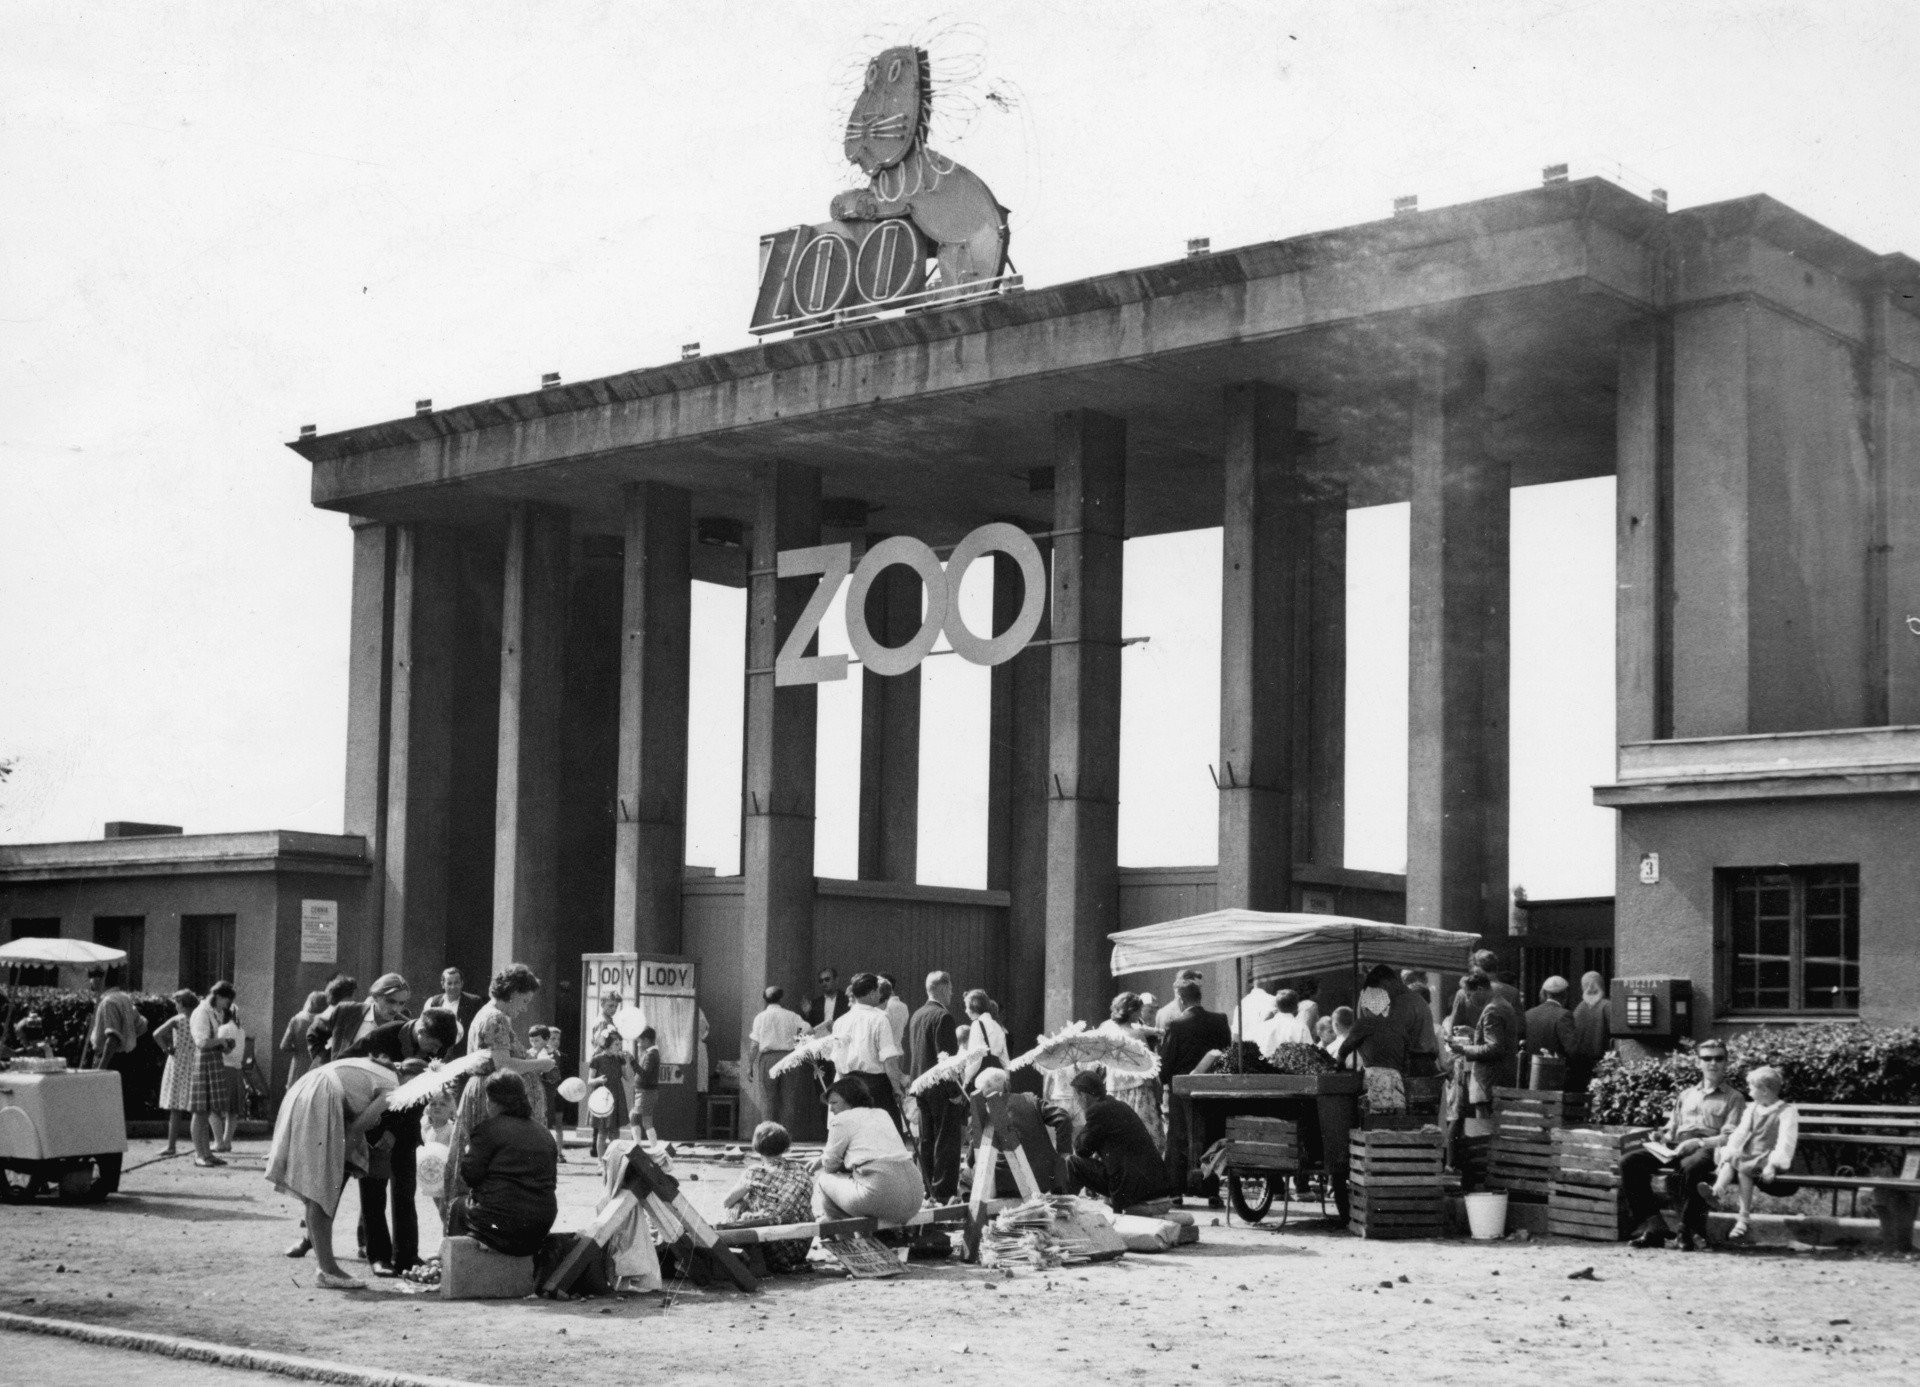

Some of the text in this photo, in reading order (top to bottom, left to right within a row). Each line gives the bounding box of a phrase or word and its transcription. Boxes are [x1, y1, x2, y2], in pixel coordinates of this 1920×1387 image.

[774, 522, 1046, 687] ZOO
[1645, 861, 1654, 876] 3
[588, 966, 635, 986] LODY
[646, 966, 688, 987] LODY
